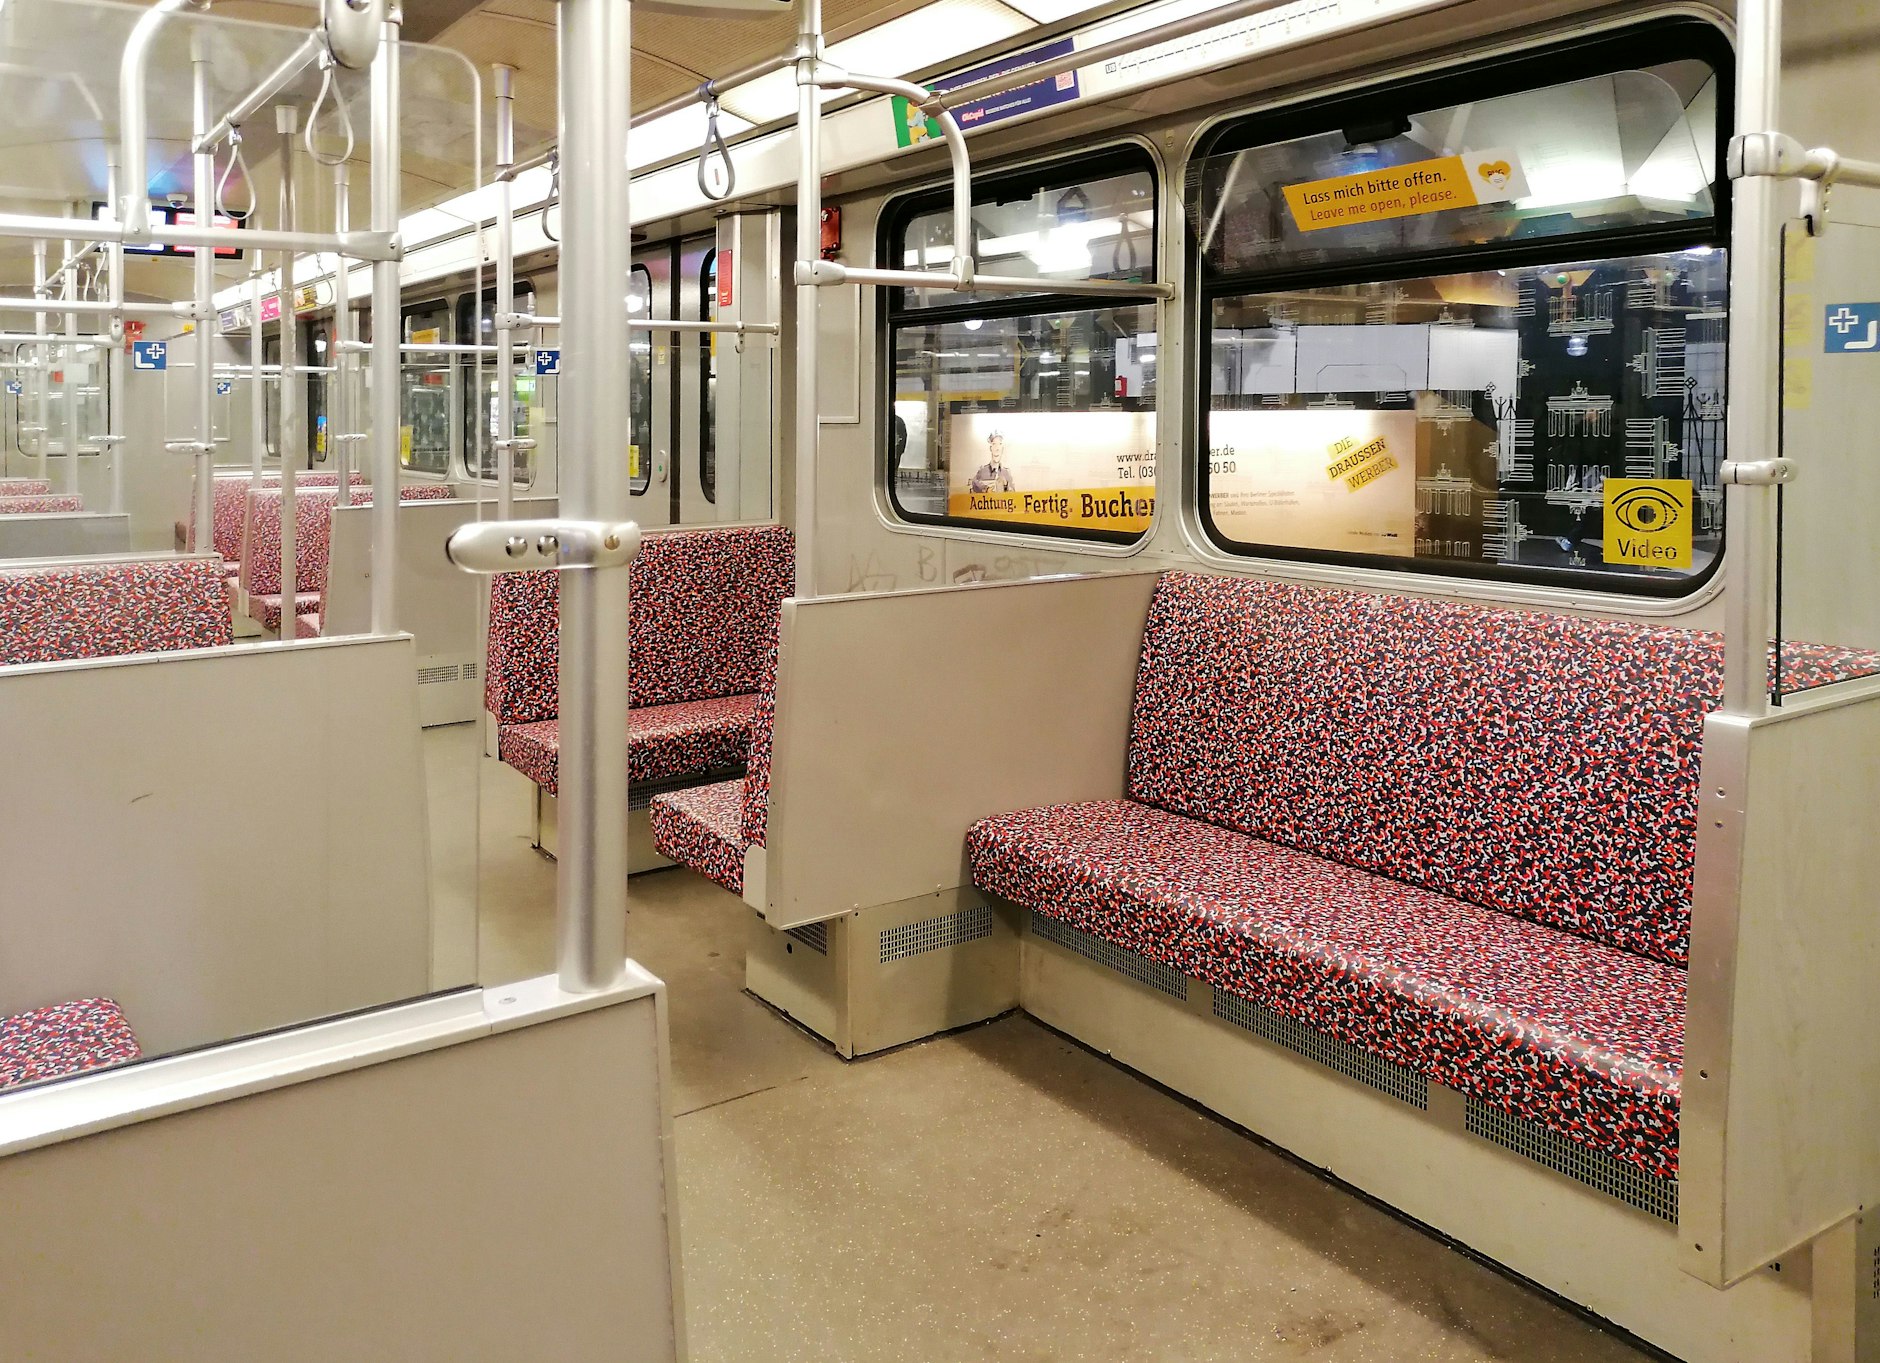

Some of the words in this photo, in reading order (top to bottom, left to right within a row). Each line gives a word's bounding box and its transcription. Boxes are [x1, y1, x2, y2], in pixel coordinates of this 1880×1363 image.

[1303, 190, 1331, 205] Lass
[1334, 180, 1364, 201] mich
[1368, 177, 1400, 194] bitte
[1404, 170, 1447, 188] offen.
[1310, 206, 1344, 221] Leave
[1348, 202, 1367, 215] me
[1370, 197, 1406, 214] open,
[1410, 189, 1457, 208] please.
[1328, 438, 1387, 479] DRAUSSEN
[1334, 436, 1353, 454] DIE
[1117, 466, 1136, 479] Tel.
[1223, 460, 1236, 474] 50
[1347, 456, 1395, 489] WERBER
[969, 495, 1017, 513] Achtung.
[1023, 493, 1073, 519] Fertig.
[1617, 538, 1678, 560] Video
